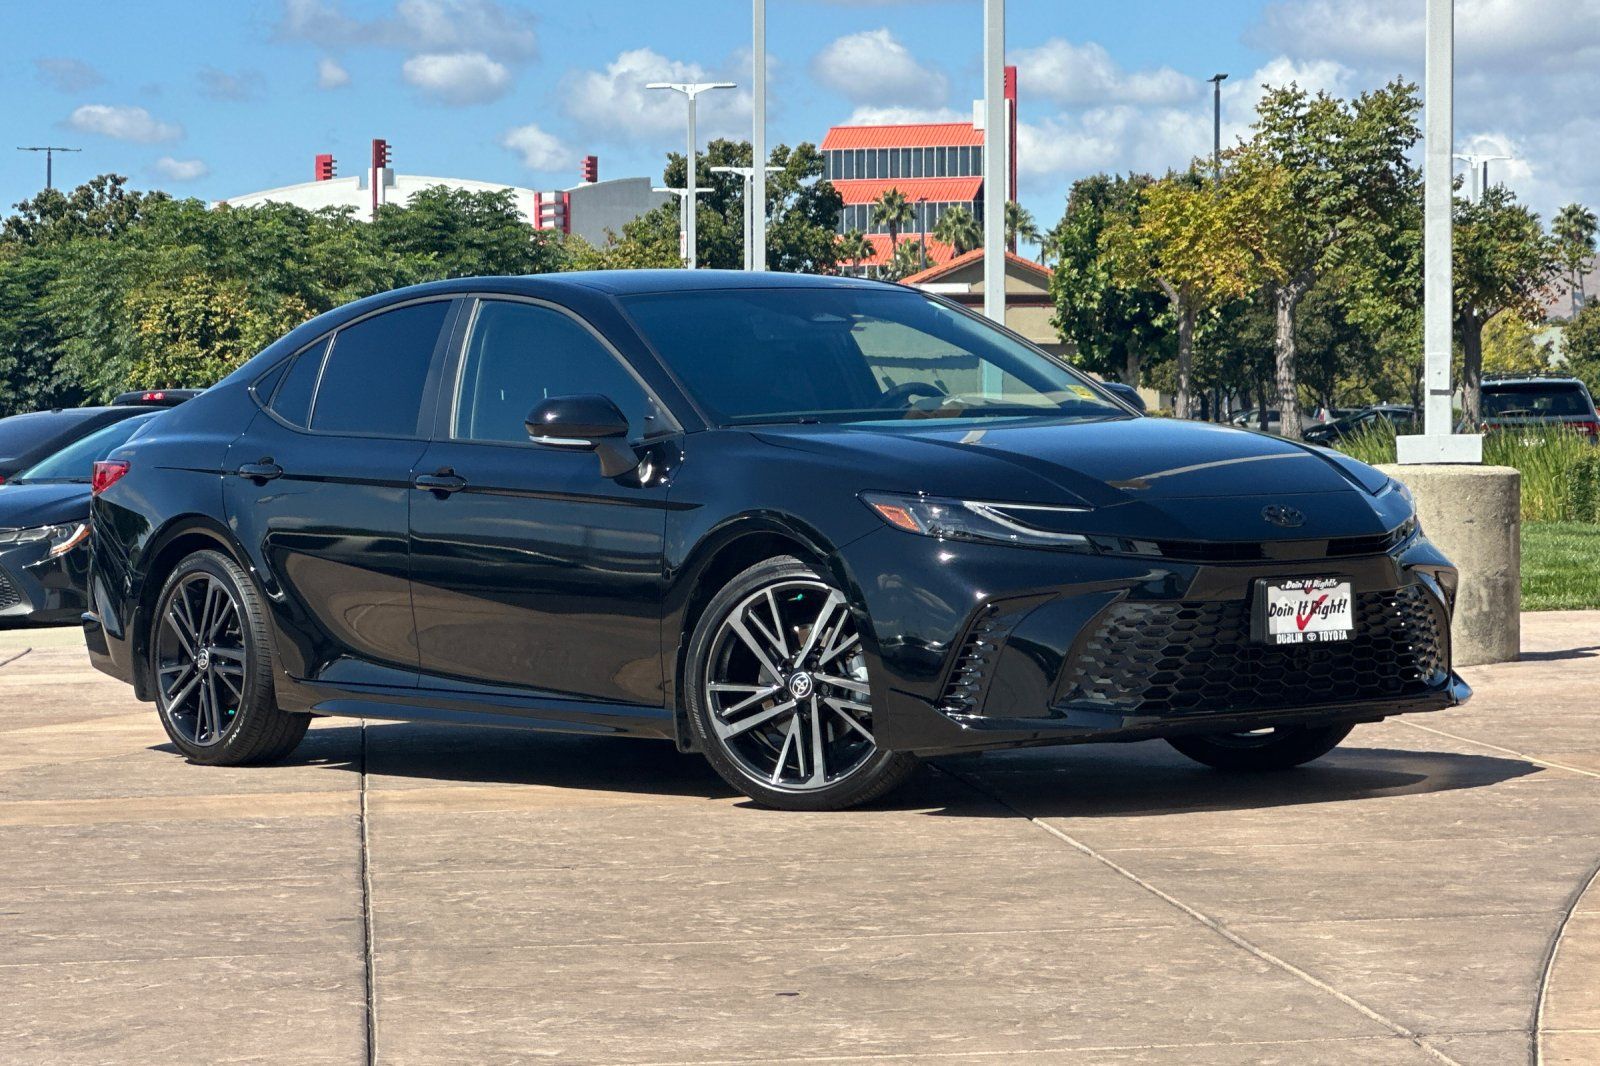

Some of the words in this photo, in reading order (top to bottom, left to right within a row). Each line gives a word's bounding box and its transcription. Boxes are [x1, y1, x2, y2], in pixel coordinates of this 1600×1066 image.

[1304, 579, 1313, 588] It
[1269, 600, 1297, 618] Doin'
[1298, 600, 1308, 616] It
[1311, 599, 1347, 620] Right!
[1277, 632, 1303, 644] DUBLIN
[1319, 630, 1348, 642] TOYOTA
